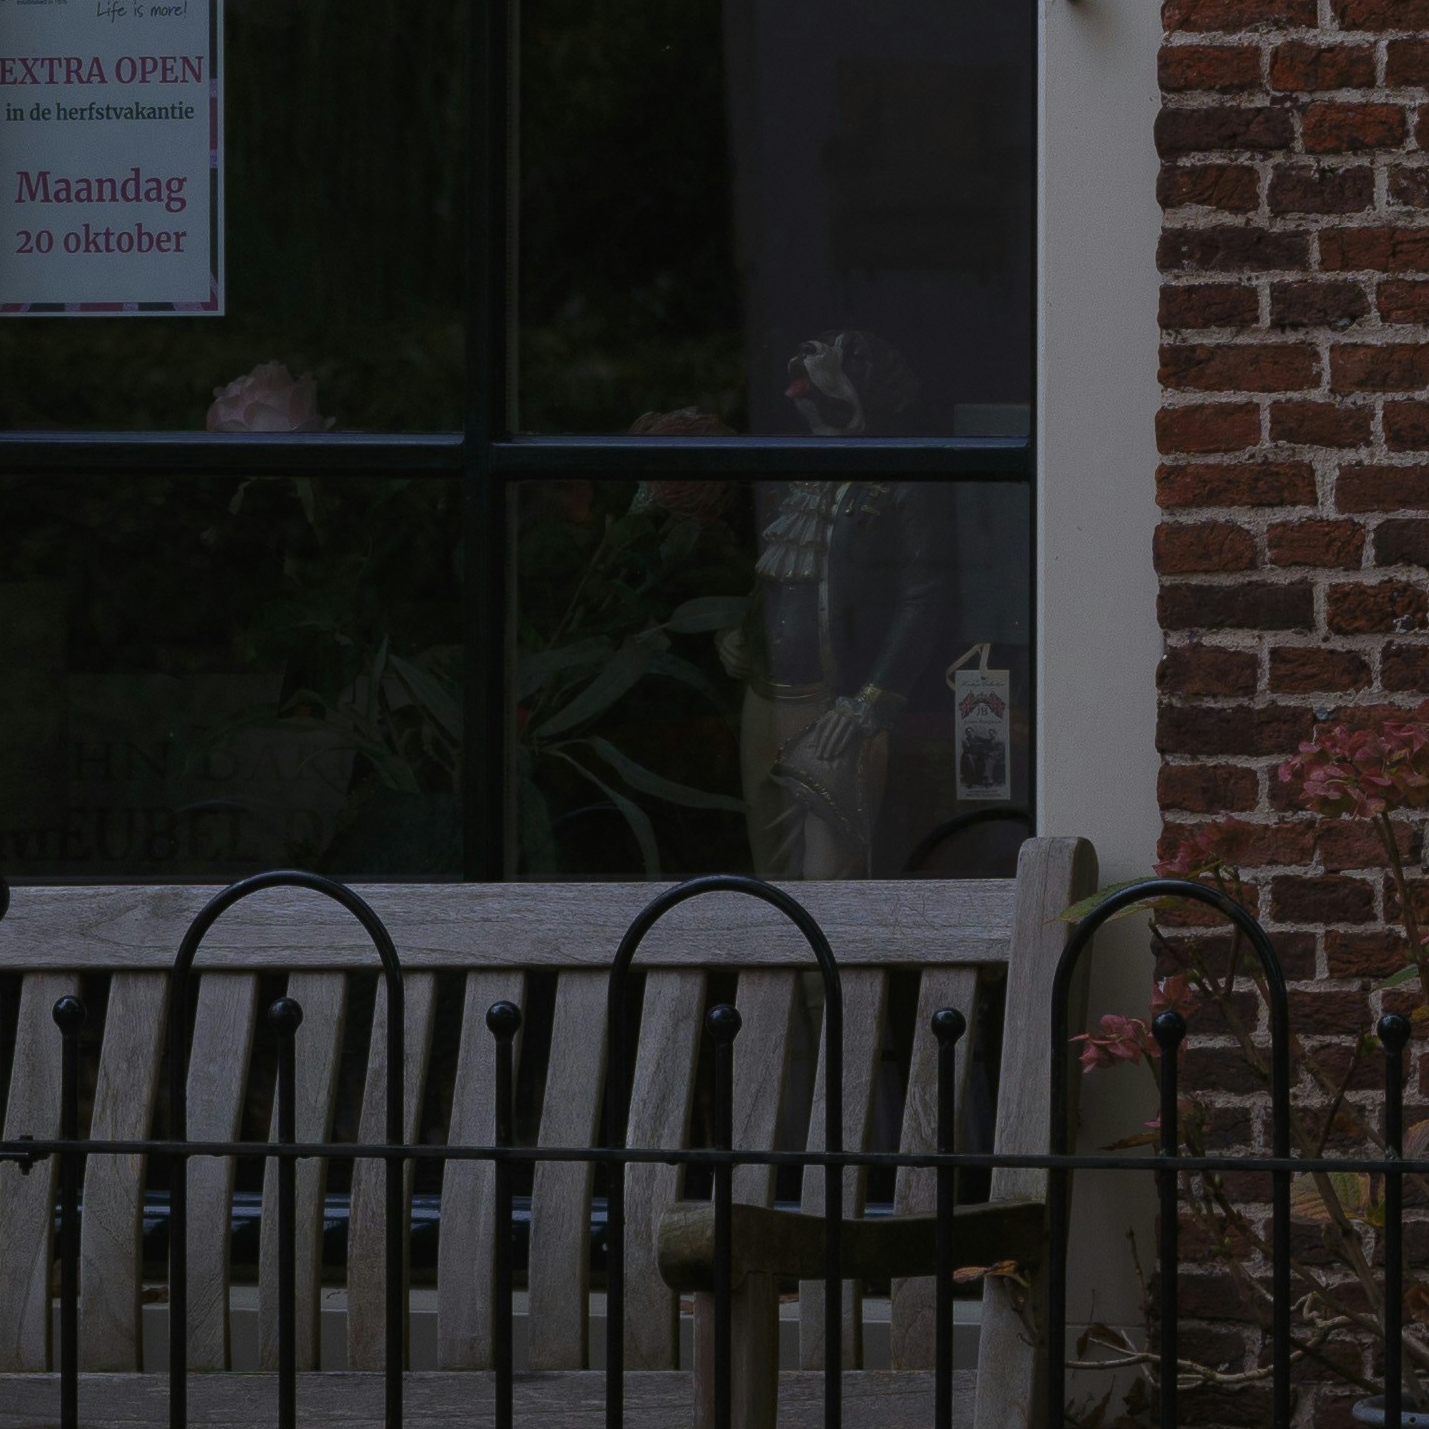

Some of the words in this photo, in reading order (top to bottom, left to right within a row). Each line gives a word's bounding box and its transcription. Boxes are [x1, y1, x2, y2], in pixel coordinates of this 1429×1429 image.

[97, 1, 127, 23] Life
[134, 0, 144, 18] is
[150, 1, 188, 18] more!
[115, 55, 204, 84] OPEN
[5, 103, 25, 121] in
[29, 102, 51, 121] de
[55, 101, 195, 121] herfstvakantie
[14, 167, 188, 213] Maandag
[16, 228, 55, 254] 20
[63, 223, 187, 254] oktober
